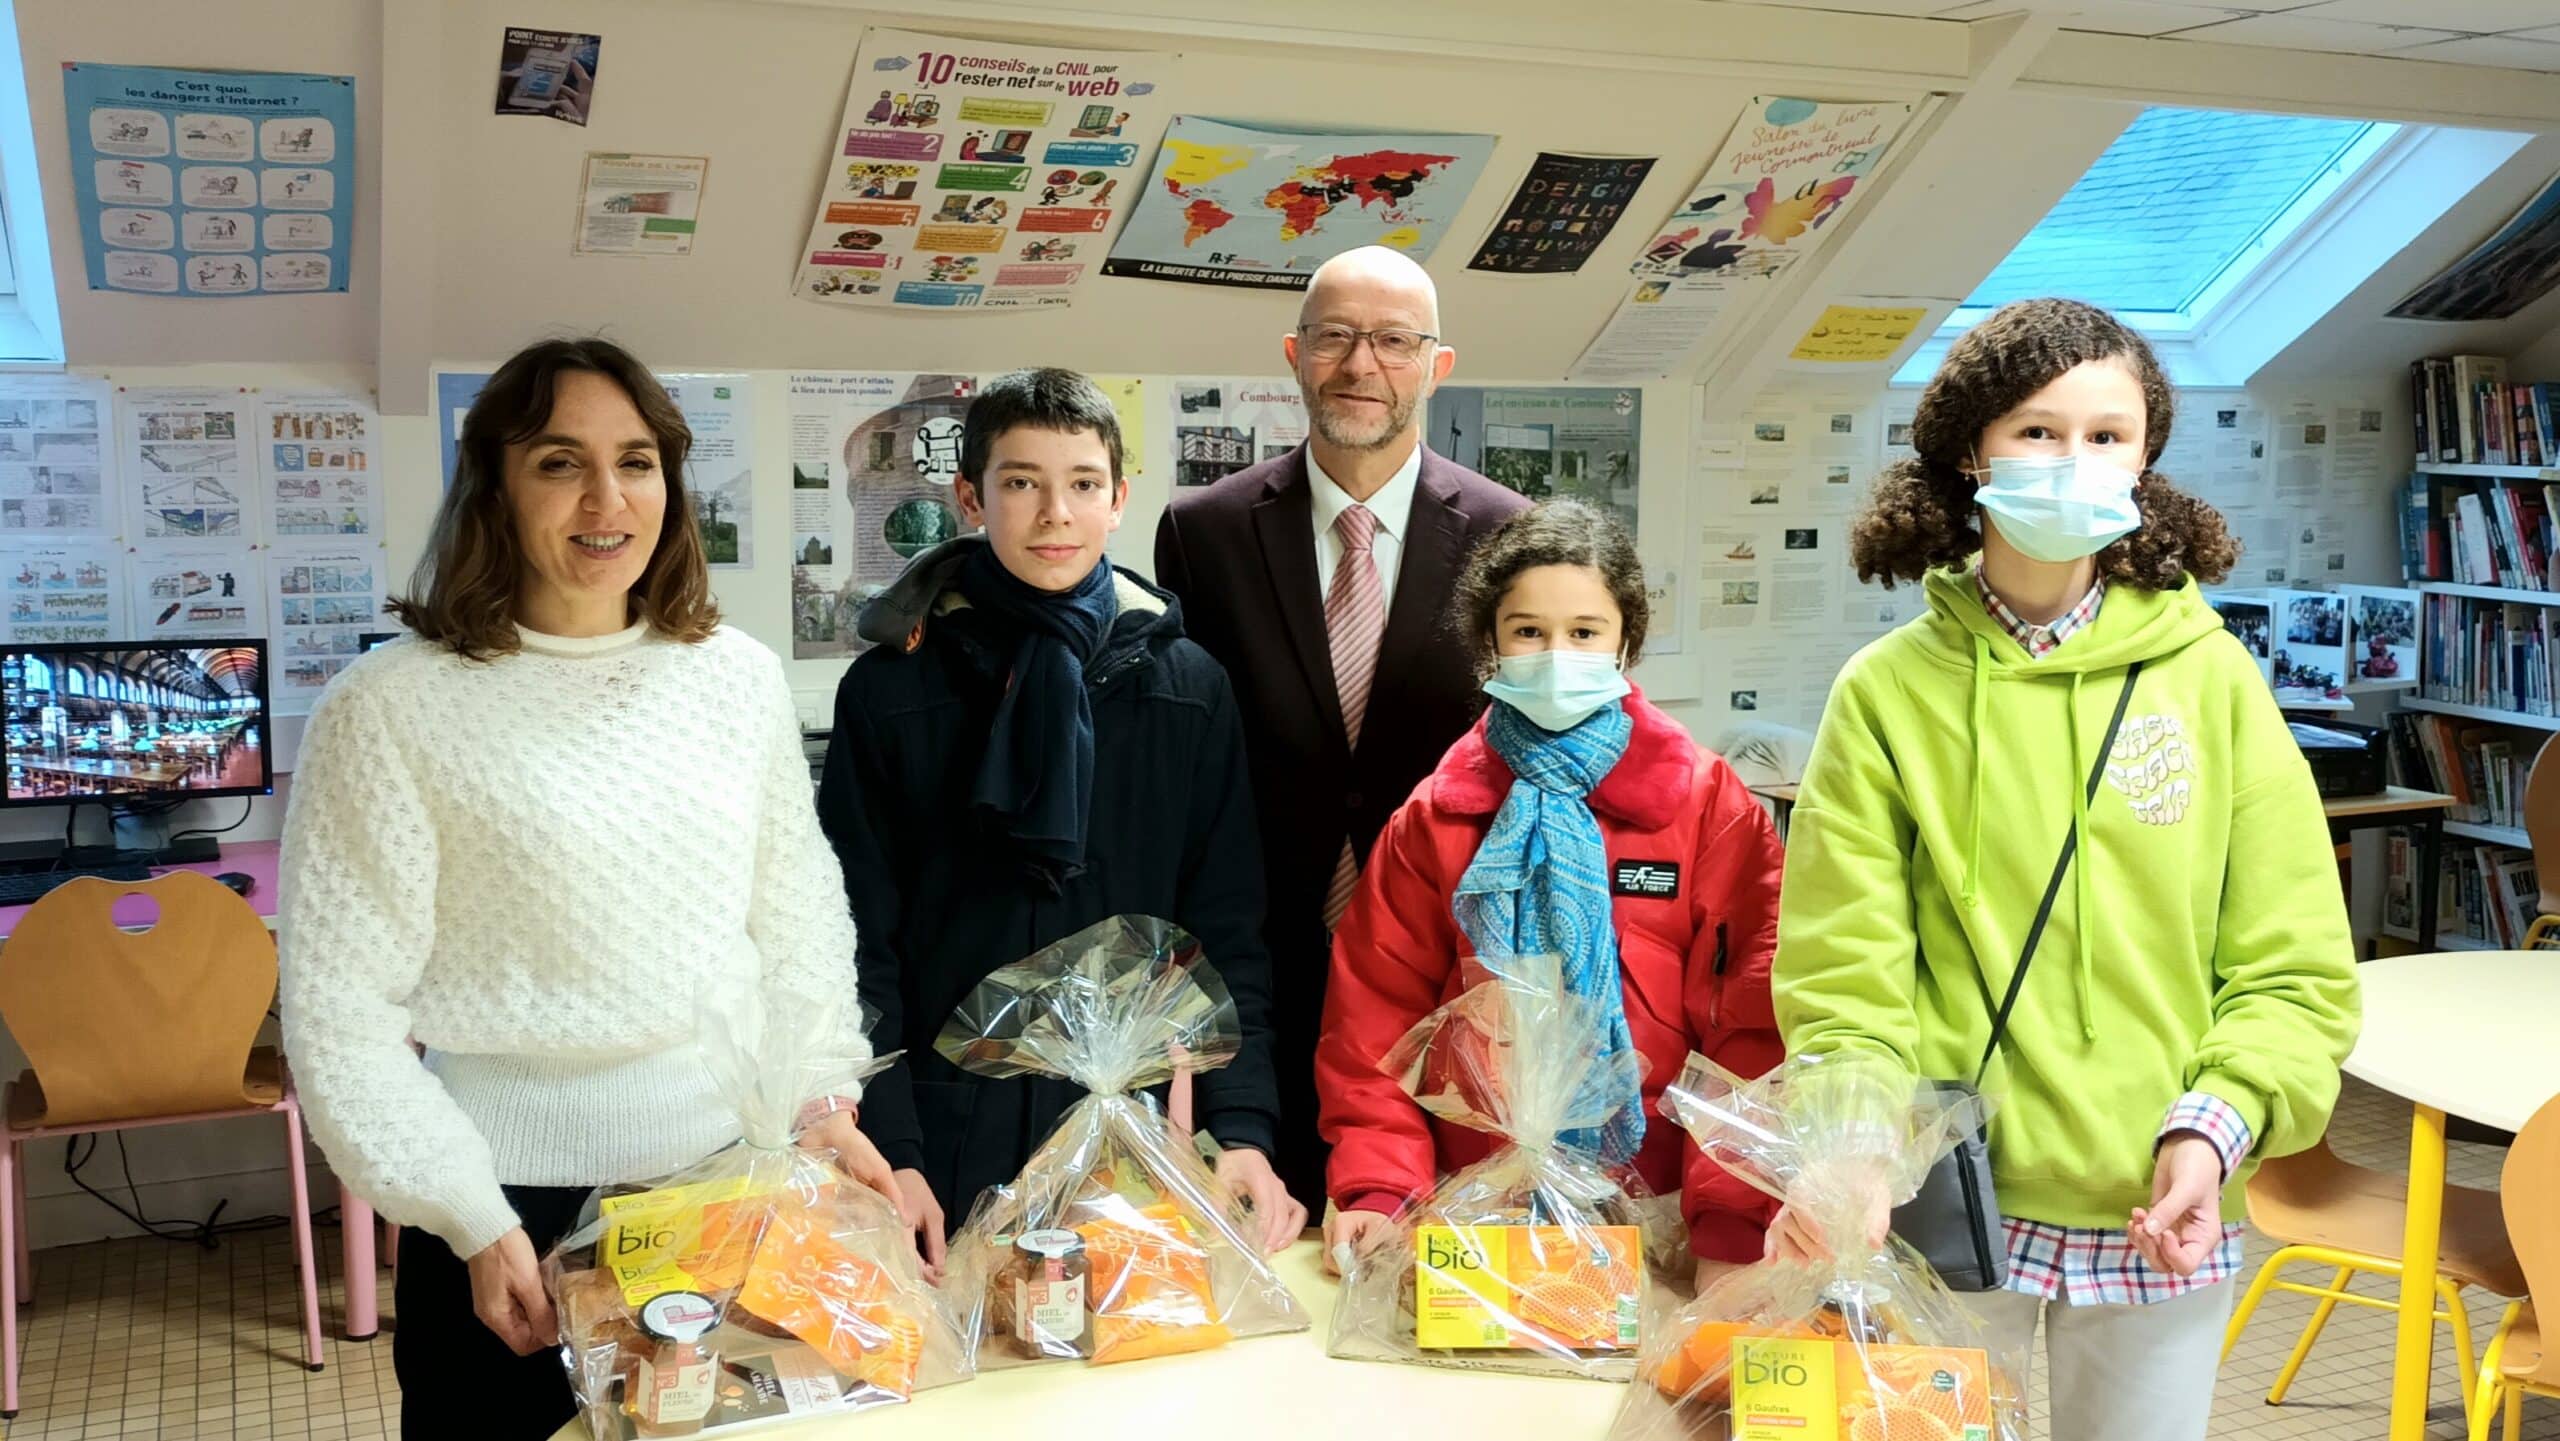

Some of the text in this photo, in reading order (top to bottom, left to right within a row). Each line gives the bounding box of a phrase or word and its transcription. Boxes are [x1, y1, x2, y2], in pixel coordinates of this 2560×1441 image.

[917, 52, 1119, 85] 10 conseils de la CNIL pour
[175, 81, 248, 94] C'est quoi
[954, 72, 1120, 97] rester net sur le web
[125, 88, 146, 98] les
[150, 89, 210, 104] dangers
[290, 97, 299, 105] ?
[1752, 126, 1800, 148] Salon
[1834, 106, 1879, 127] livre
[921, 134, 940, 153] 2
[1115, 145, 1135, 166] 3
[1009, 168, 1032, 190] 4
[902, 211, 917, 227] 5
[1091, 212, 1105, 230] 6
[1139, 262, 1155, 273] LA
[1196, 268, 1214, 279] DE
[1211, 269, 1225, 280] LA
[1225, 270, 1264, 283] PRESSE
[1265, 273, 1294, 285] DANS
[1294, 276, 1307, 286] LE
[803, 375, 833, 384] château
[841, 376, 858, 386] port
[1240, 391, 1302, 407] Combourg
[1504, 398, 1547, 409] environs
[1549, 398, 1562, 409] de
[1625, 882, 1670, 893] AIR FORCE
[617, 1225, 677, 1256] bio
[1427, 1233, 1484, 1271] bio
[1036, 1308, 1062, 1318] MIEL
[1743, 1344, 1808, 1387] bio
[663, 1390, 689, 1400] MIEL
[1753, 1403, 1790, 1414] Gaufres
